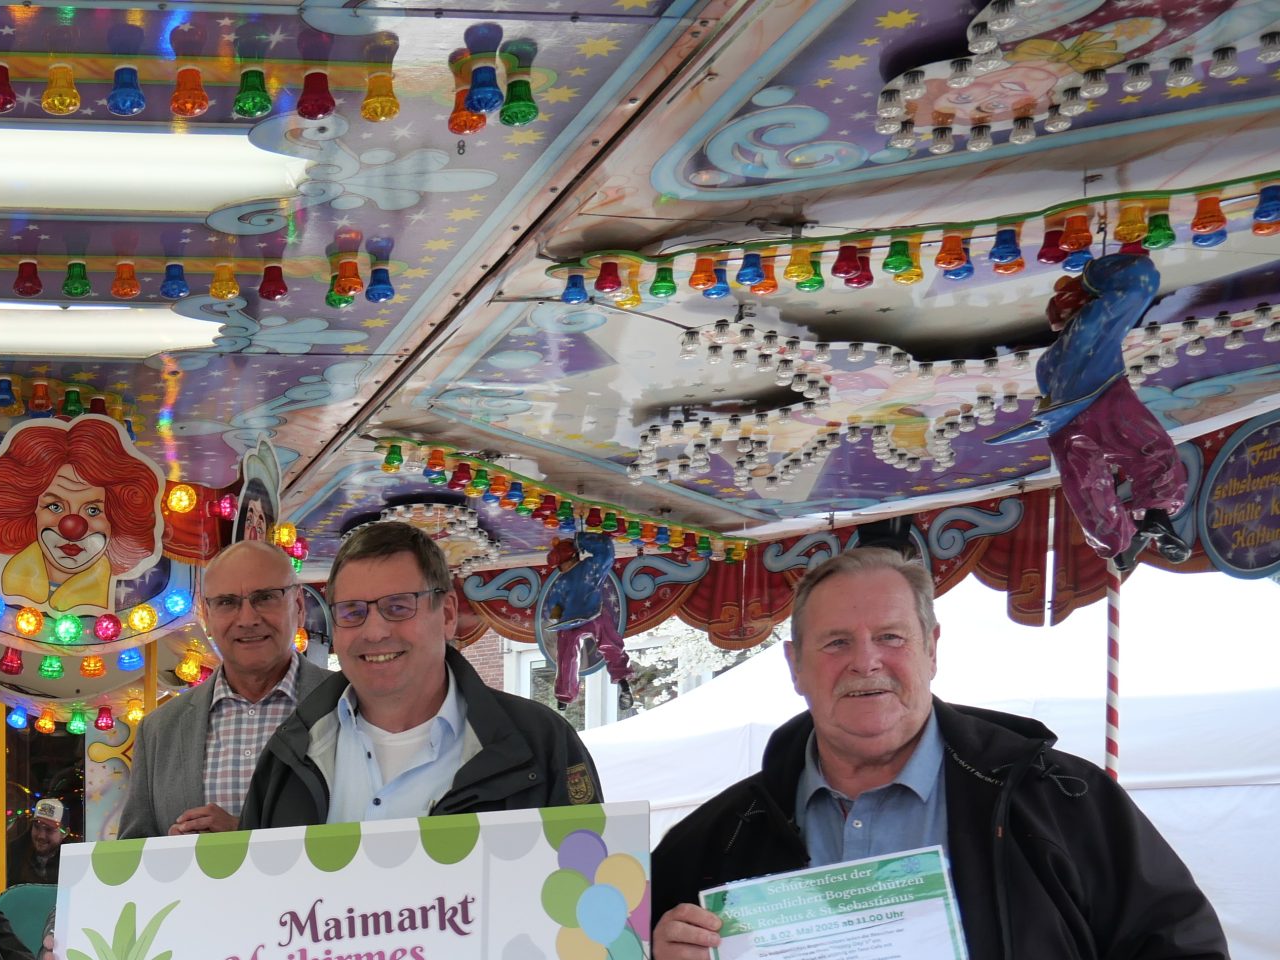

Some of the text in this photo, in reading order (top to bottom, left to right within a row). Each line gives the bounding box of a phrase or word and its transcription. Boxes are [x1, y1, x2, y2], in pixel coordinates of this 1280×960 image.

[849, 866, 873, 880] der
[825, 874, 925, 902] Bogenschützen
[278, 894, 475, 947] Maimarkt
[757, 910, 804, 928] Rochus
[838, 890, 915, 913] Sebastianus
[815, 921, 840, 933] 2025
[841, 918, 854, 928] ab
[855, 913, 883, 926] 11.00
[885, 909, 905, 920] Uhr
